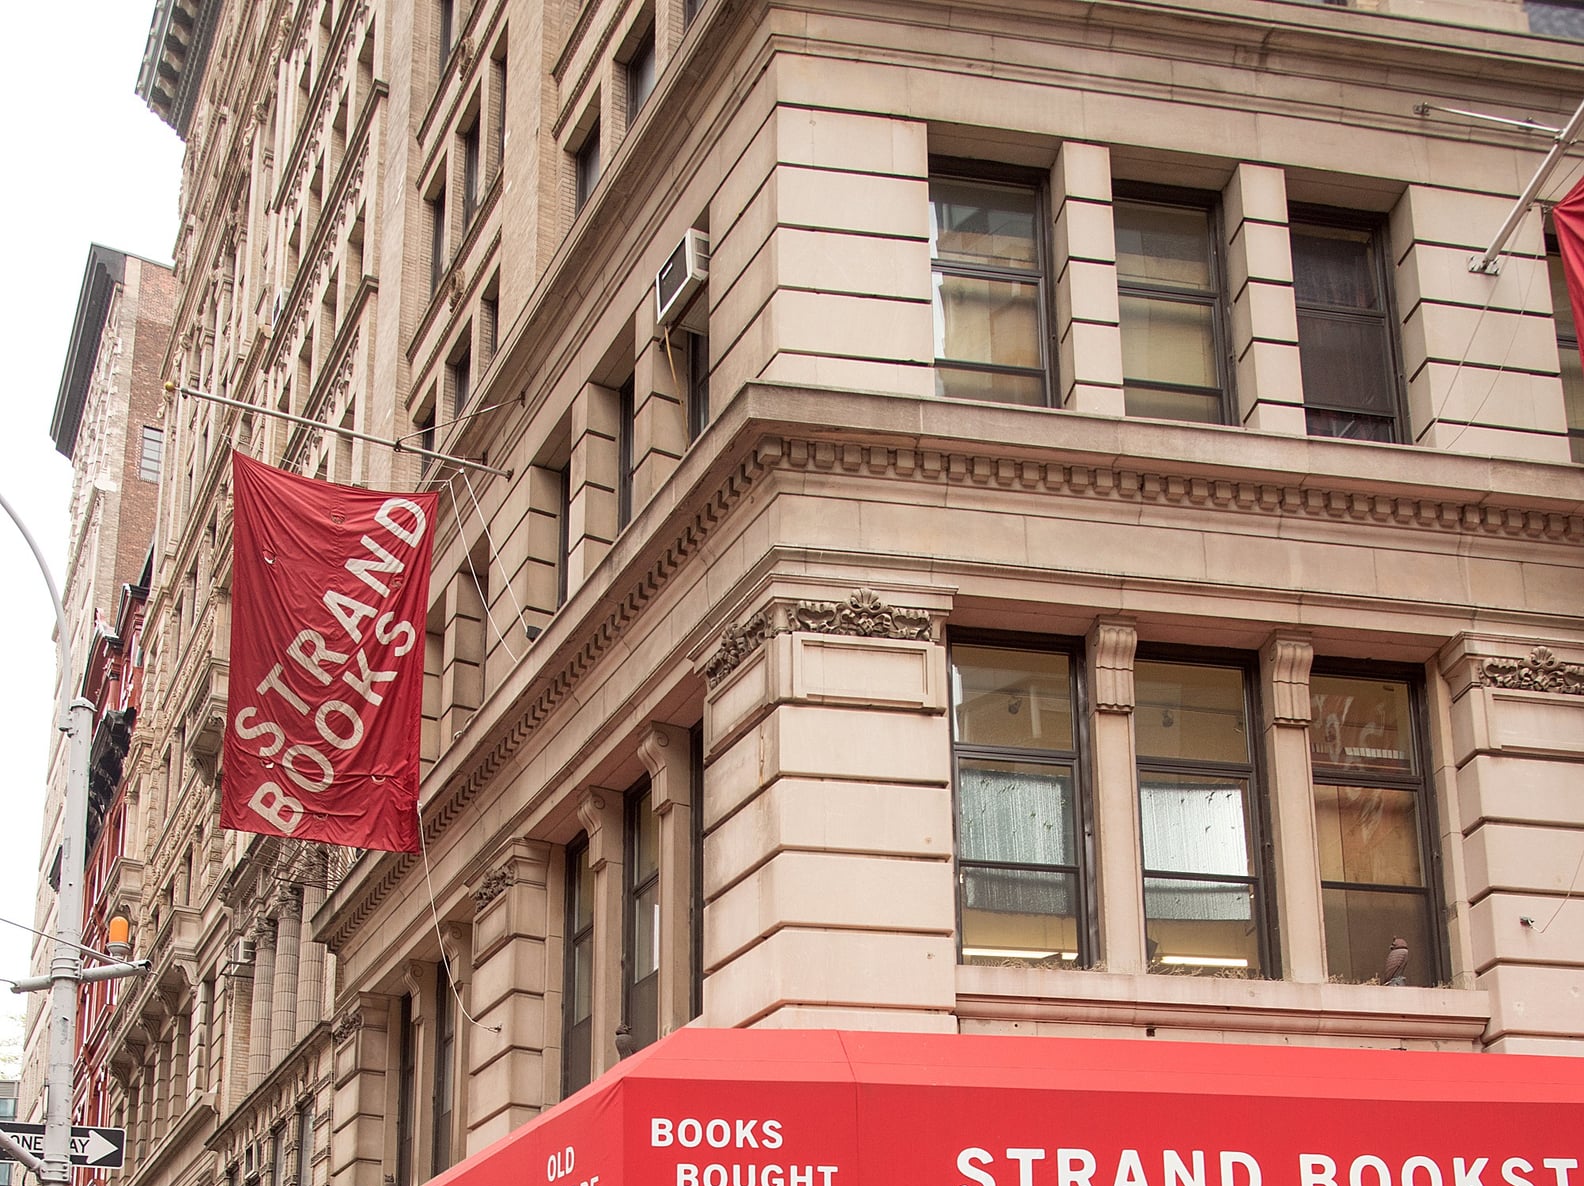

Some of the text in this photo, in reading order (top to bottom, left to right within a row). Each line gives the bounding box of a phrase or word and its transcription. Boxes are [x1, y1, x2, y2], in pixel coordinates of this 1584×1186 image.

[235, 498, 427, 756] STRAND
[248, 611, 416, 835] BOOKS
[70, 1138, 90, 1153] AY
[650, 1117, 784, 1149] BOOKS
[547, 1146, 575, 1183] OLD
